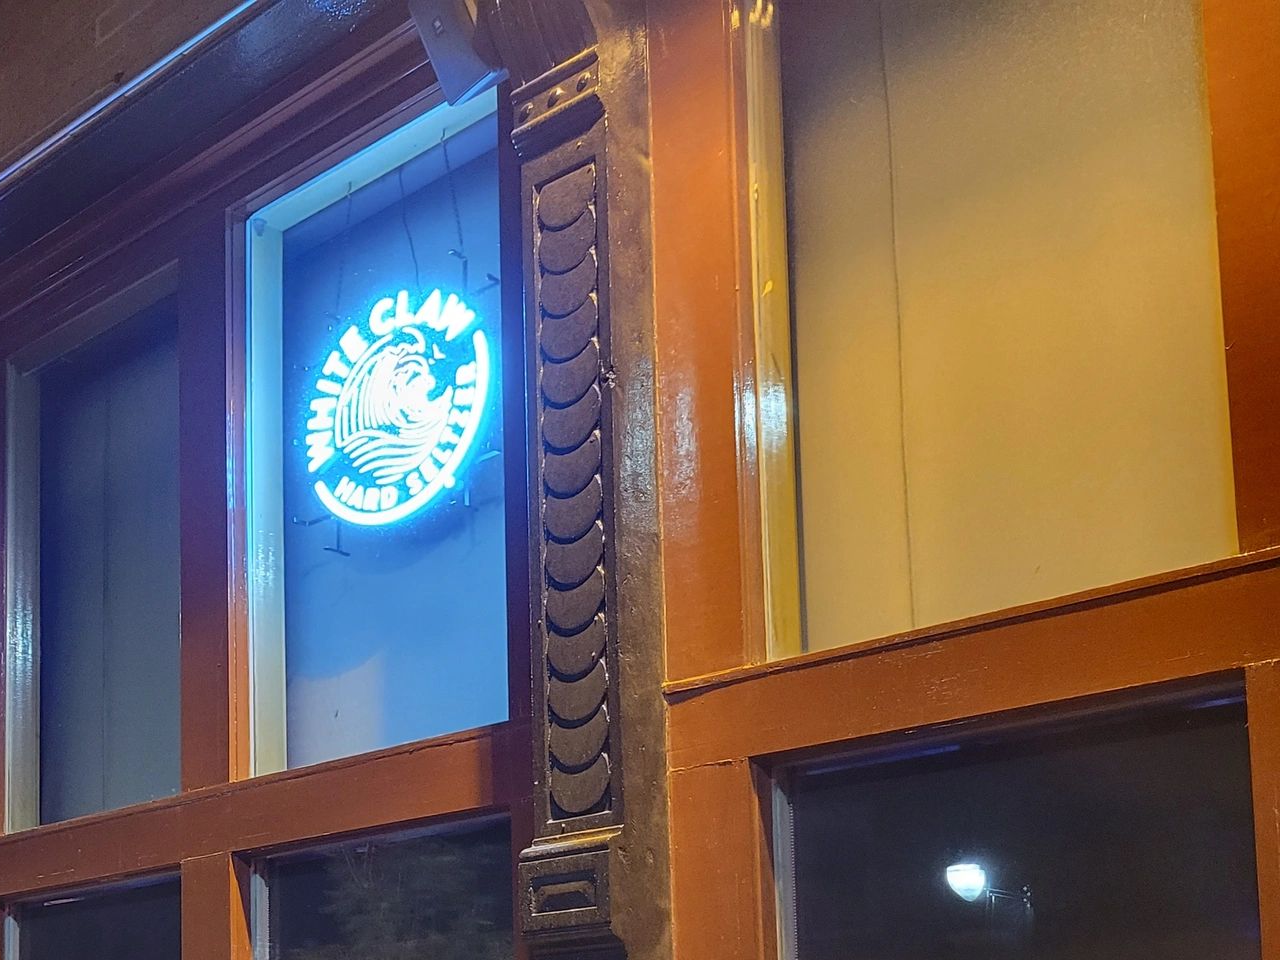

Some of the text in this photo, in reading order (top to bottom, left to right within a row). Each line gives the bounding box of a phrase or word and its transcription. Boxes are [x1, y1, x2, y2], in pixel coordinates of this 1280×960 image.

[305, 288, 476, 473] WHITE CLAW
[333, 476, 399, 512] HARD
